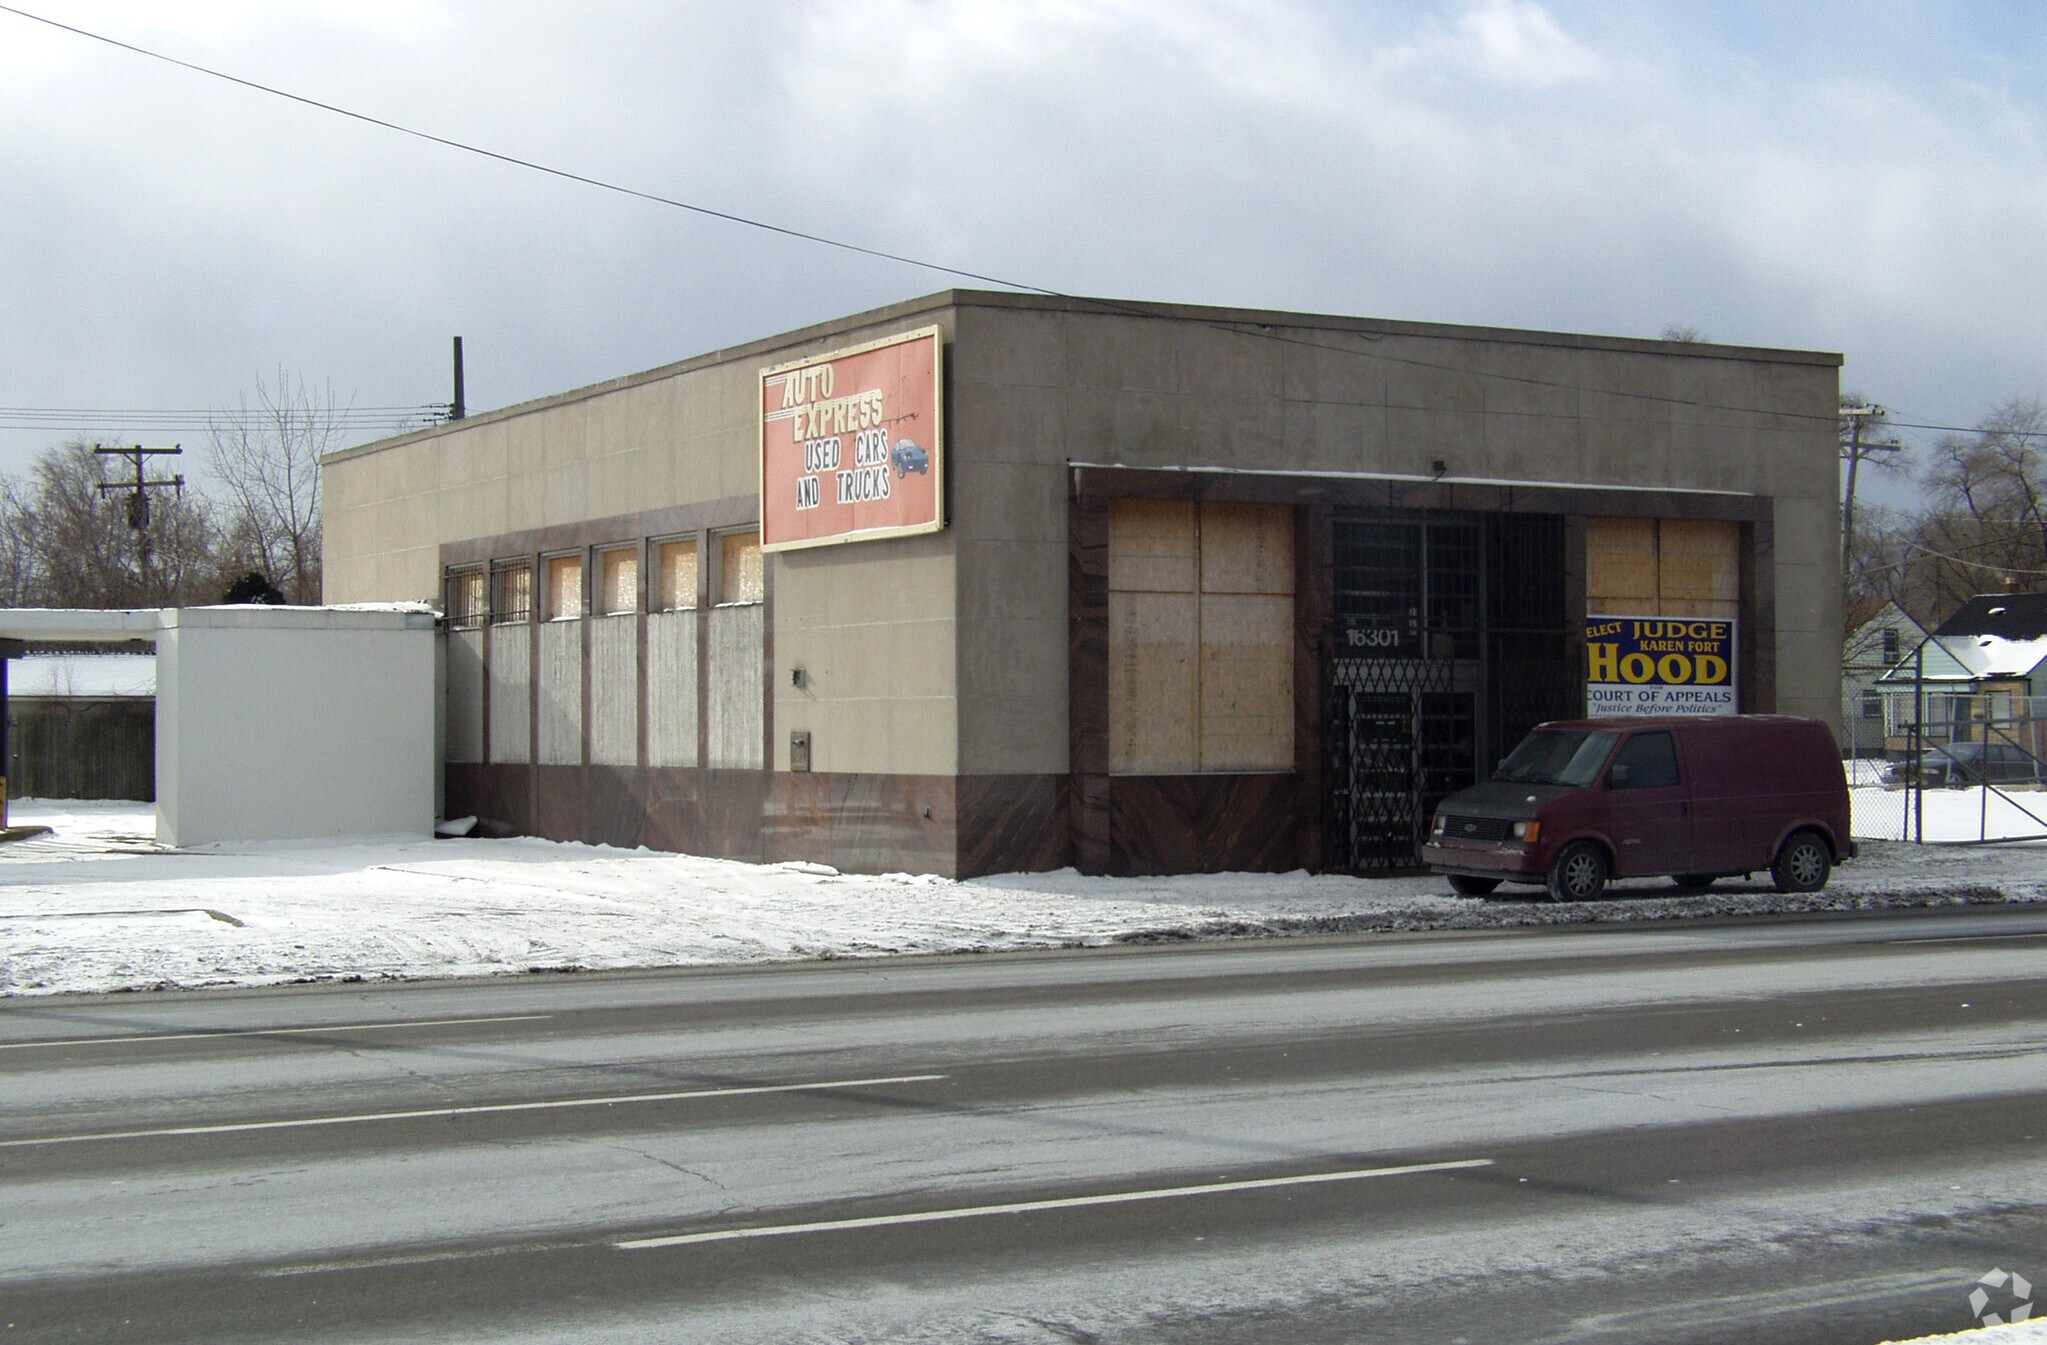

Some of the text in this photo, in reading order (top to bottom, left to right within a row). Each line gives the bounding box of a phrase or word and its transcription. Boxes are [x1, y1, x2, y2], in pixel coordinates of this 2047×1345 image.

[781, 363, 834, 409] AUTO
[793, 388, 883, 443] EXPRESS
[805, 428, 888, 472] USED CARS
[796, 467, 890, 511] AND TRUCKS
[1346, 629, 1399, 647] 16301
[1586, 621, 1727, 640] ELECT JUDGE
[1640, 640, 1720, 653] KAREN FORT
[1587, 642, 1727, 684] HOOD
[1593, 703, 1722, 714] "Justice Before Politics"
[1638, 690, 1660, 701] OF
[1665, 691, 1731, 703] APPEALS
